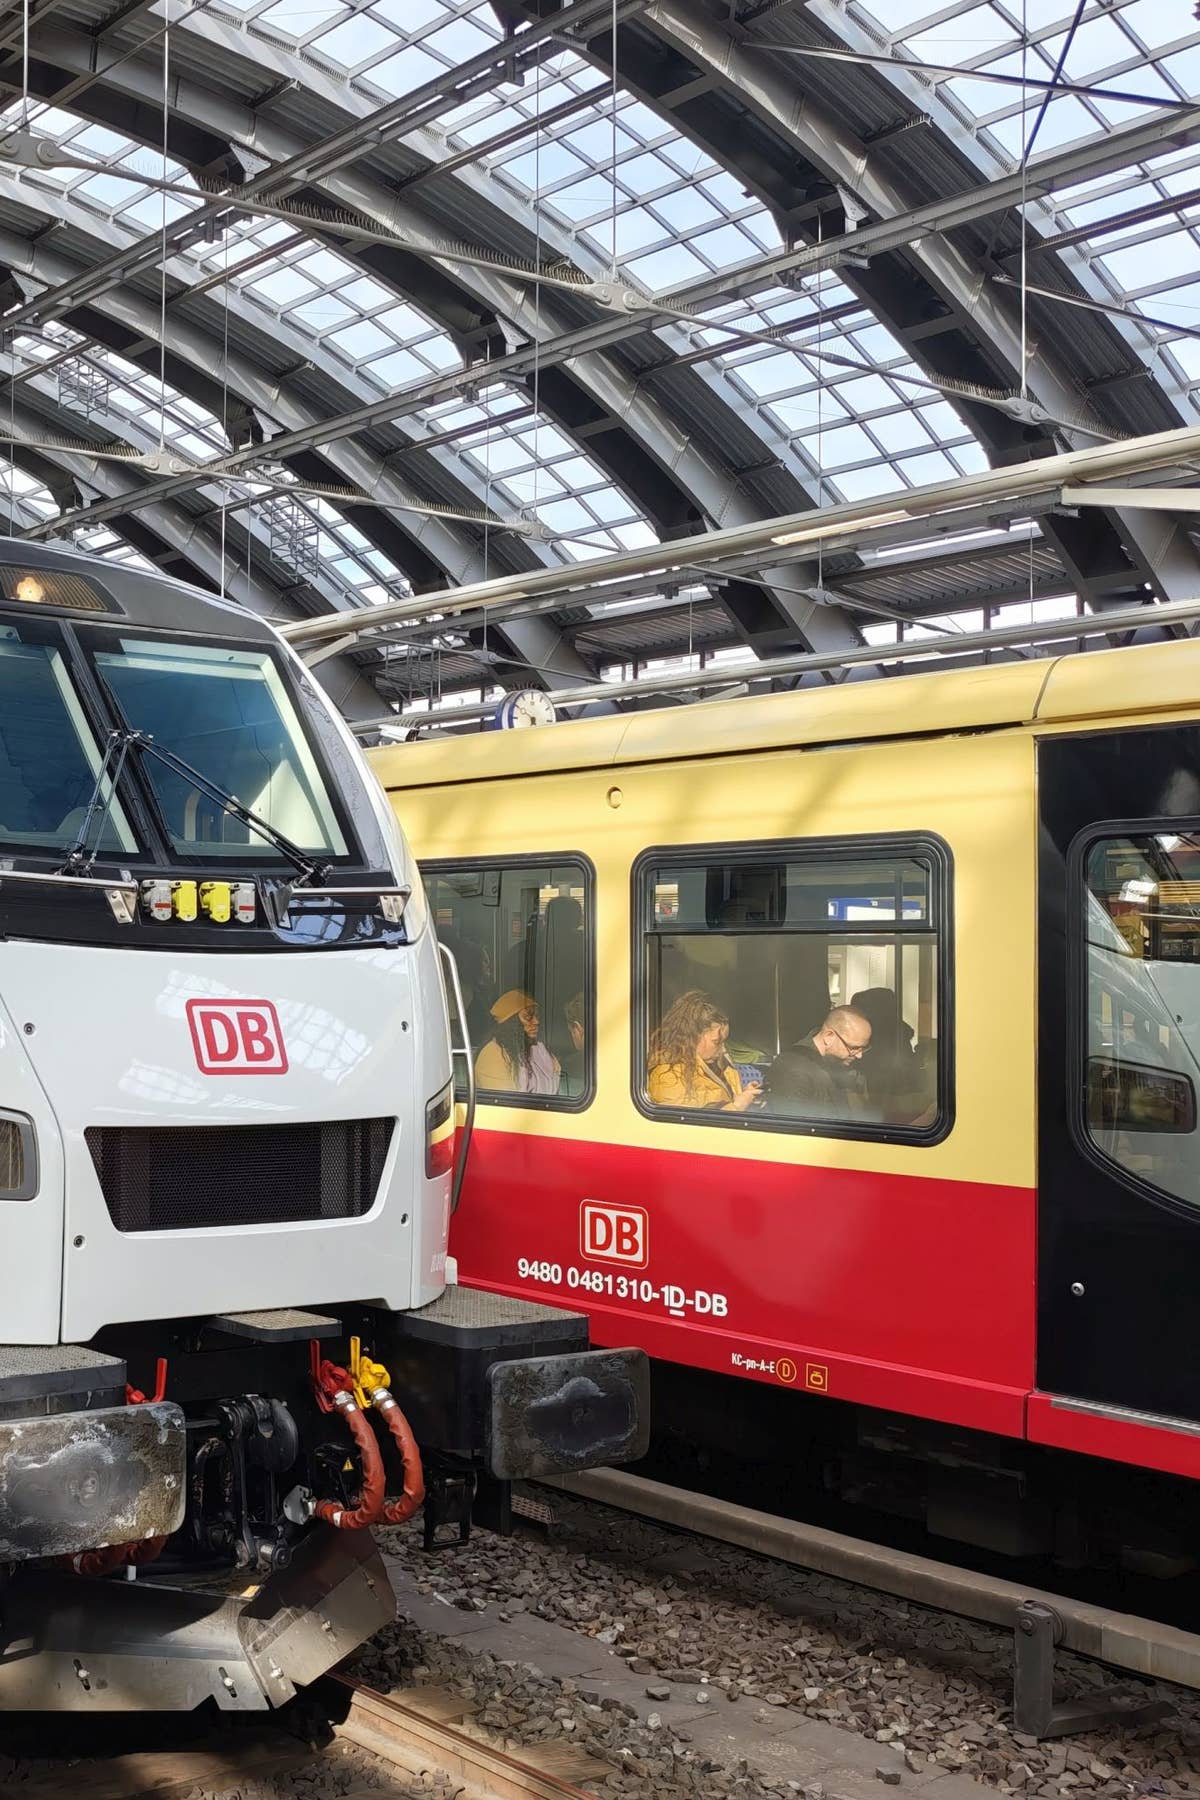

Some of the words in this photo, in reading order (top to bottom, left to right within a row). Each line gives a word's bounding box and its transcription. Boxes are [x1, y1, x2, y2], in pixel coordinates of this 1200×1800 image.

[197, 1009, 276, 1064] DB
[586, 1208, 642, 1259] DB
[517, 1257, 563, 1285] 9480
